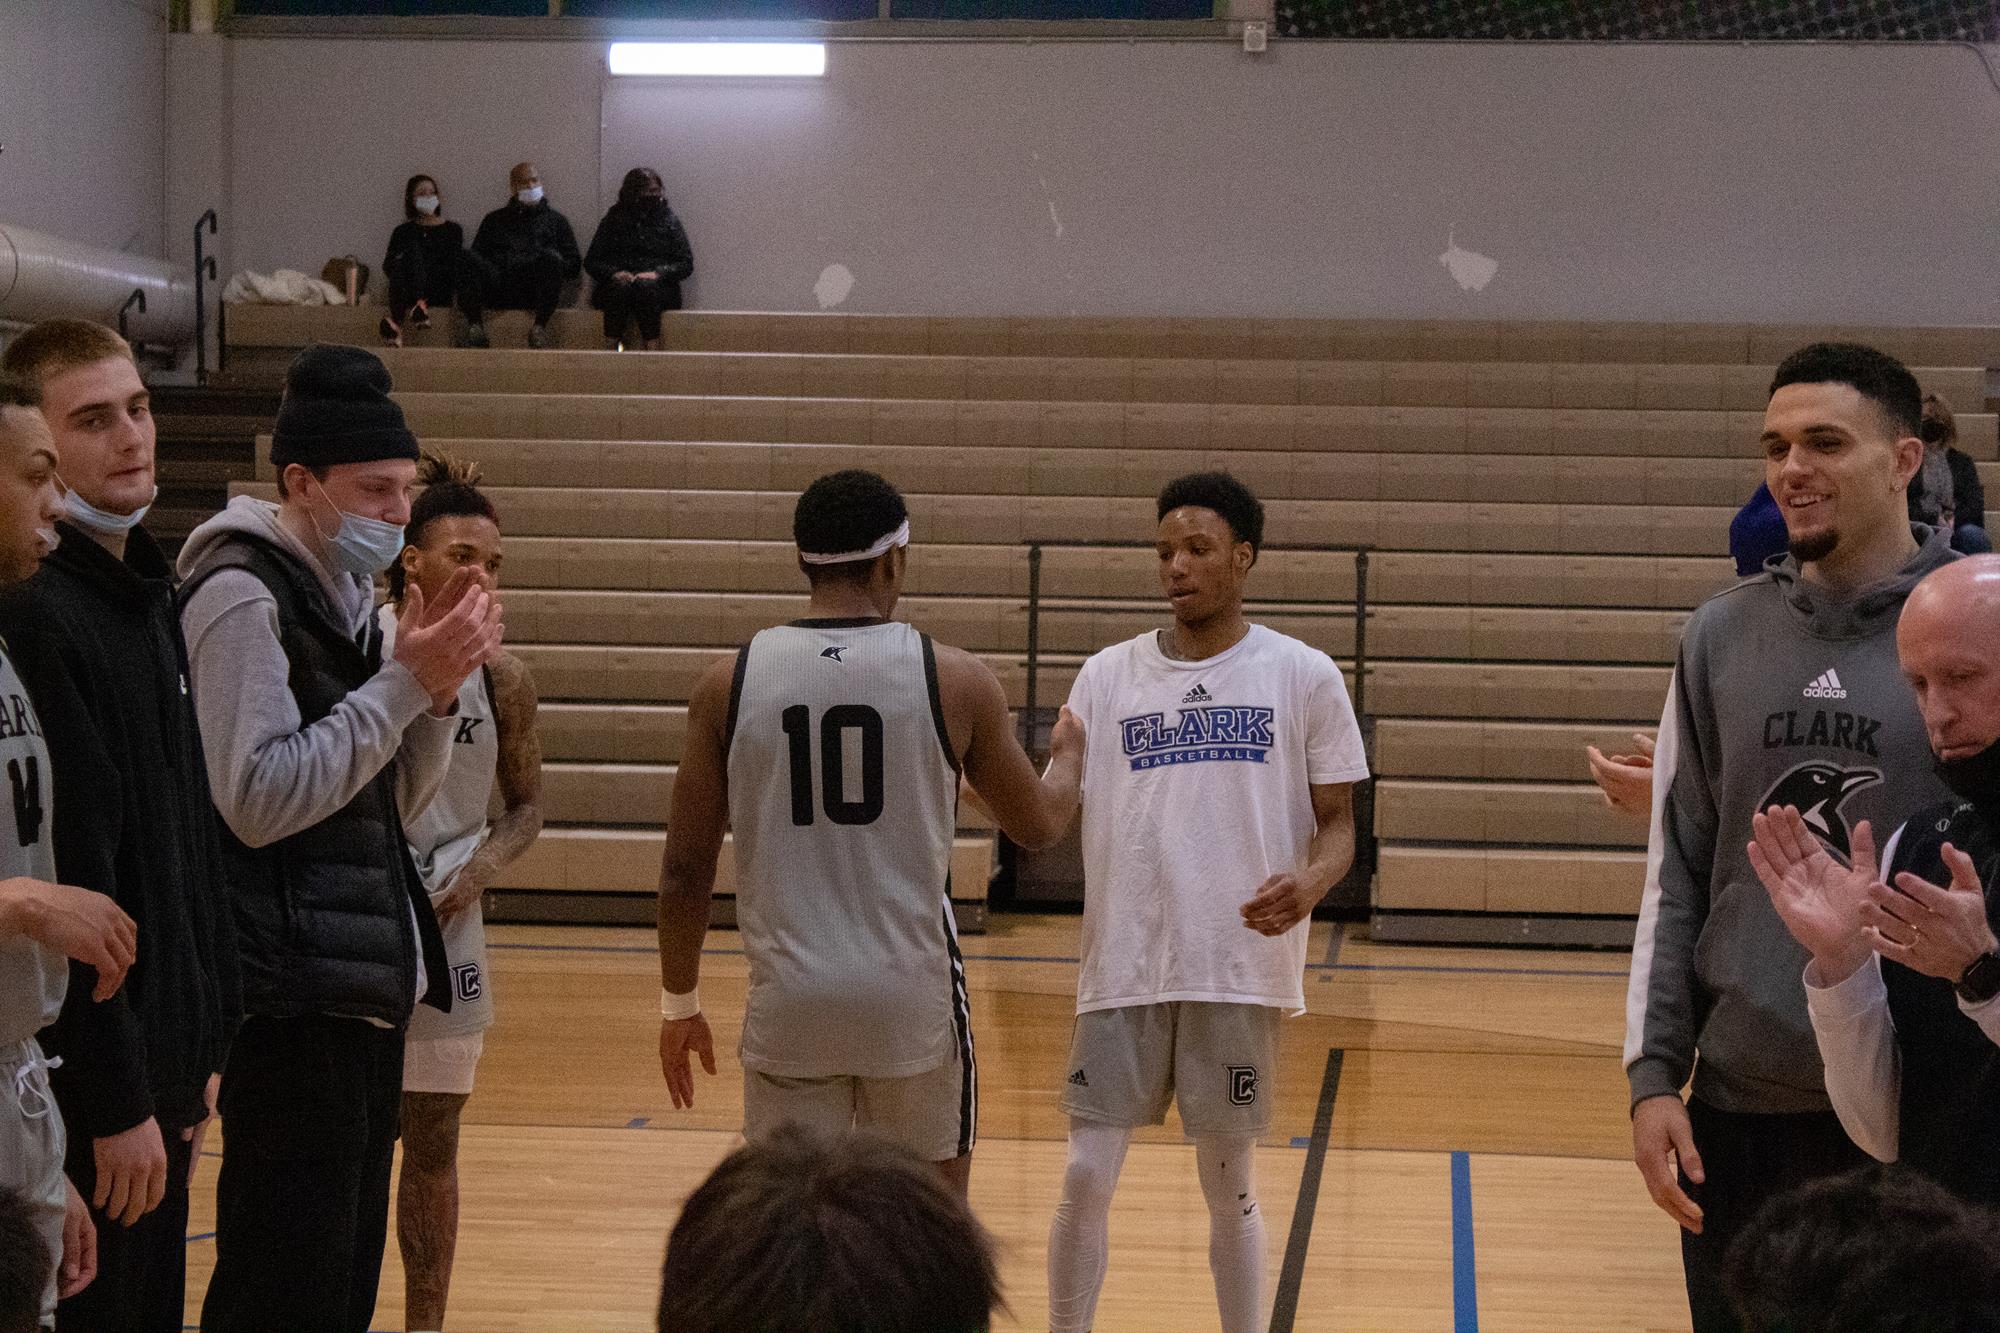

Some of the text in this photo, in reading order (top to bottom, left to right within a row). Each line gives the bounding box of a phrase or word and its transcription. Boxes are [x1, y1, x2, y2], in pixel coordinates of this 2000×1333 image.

[1182, 693, 1212, 704] adidas
[1803, 686, 1848, 699] adidas
[0, 694, 43, 739] AR
[1120, 706, 1274, 756] CLARK
[1763, 710, 1882, 757] CLARK
[782, 704, 884, 826] 10
[1140, 750, 1255, 768] BASKETBALL
